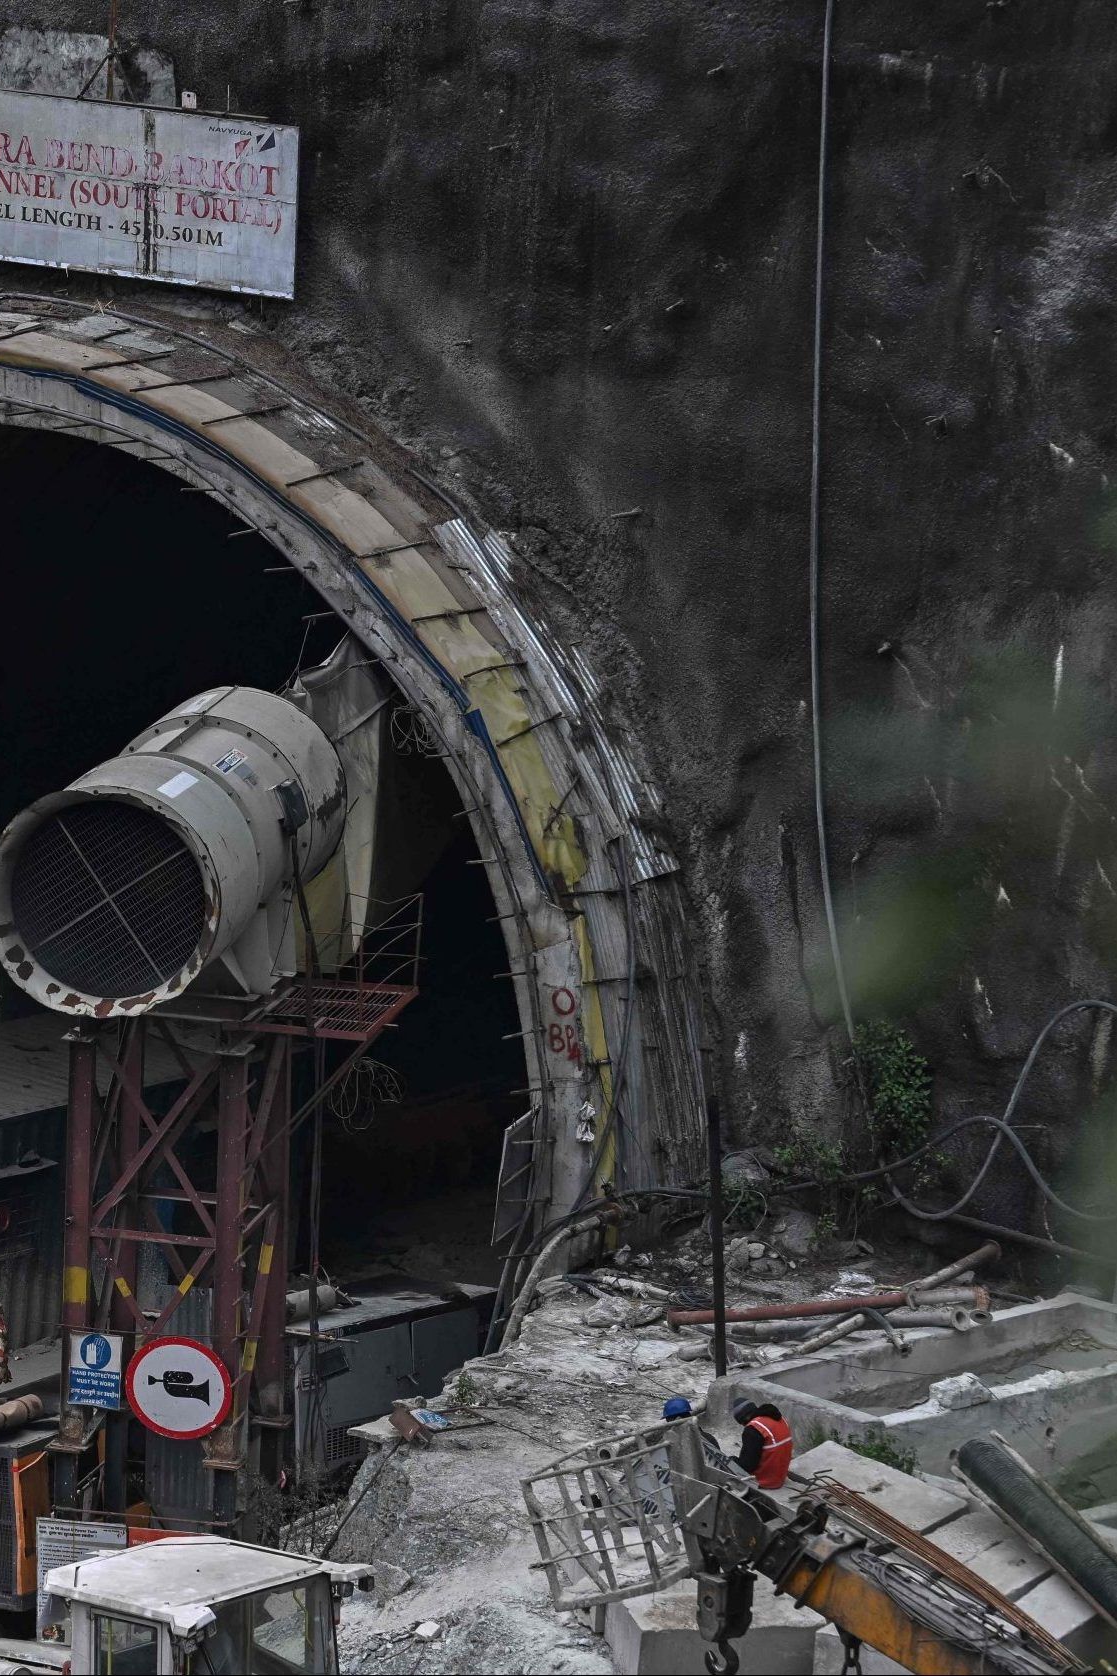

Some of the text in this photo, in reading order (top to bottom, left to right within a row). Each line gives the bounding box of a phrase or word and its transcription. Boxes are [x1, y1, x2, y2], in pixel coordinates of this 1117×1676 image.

[208, 125, 253, 137] NAVYUGA
[20, 206, 102, 231] LENGTH
[119, 219, 224, 247] 450.501M
[87, 1371, 120, 1380] PROTECTION
[99, 1380, 115, 1388] WORN
